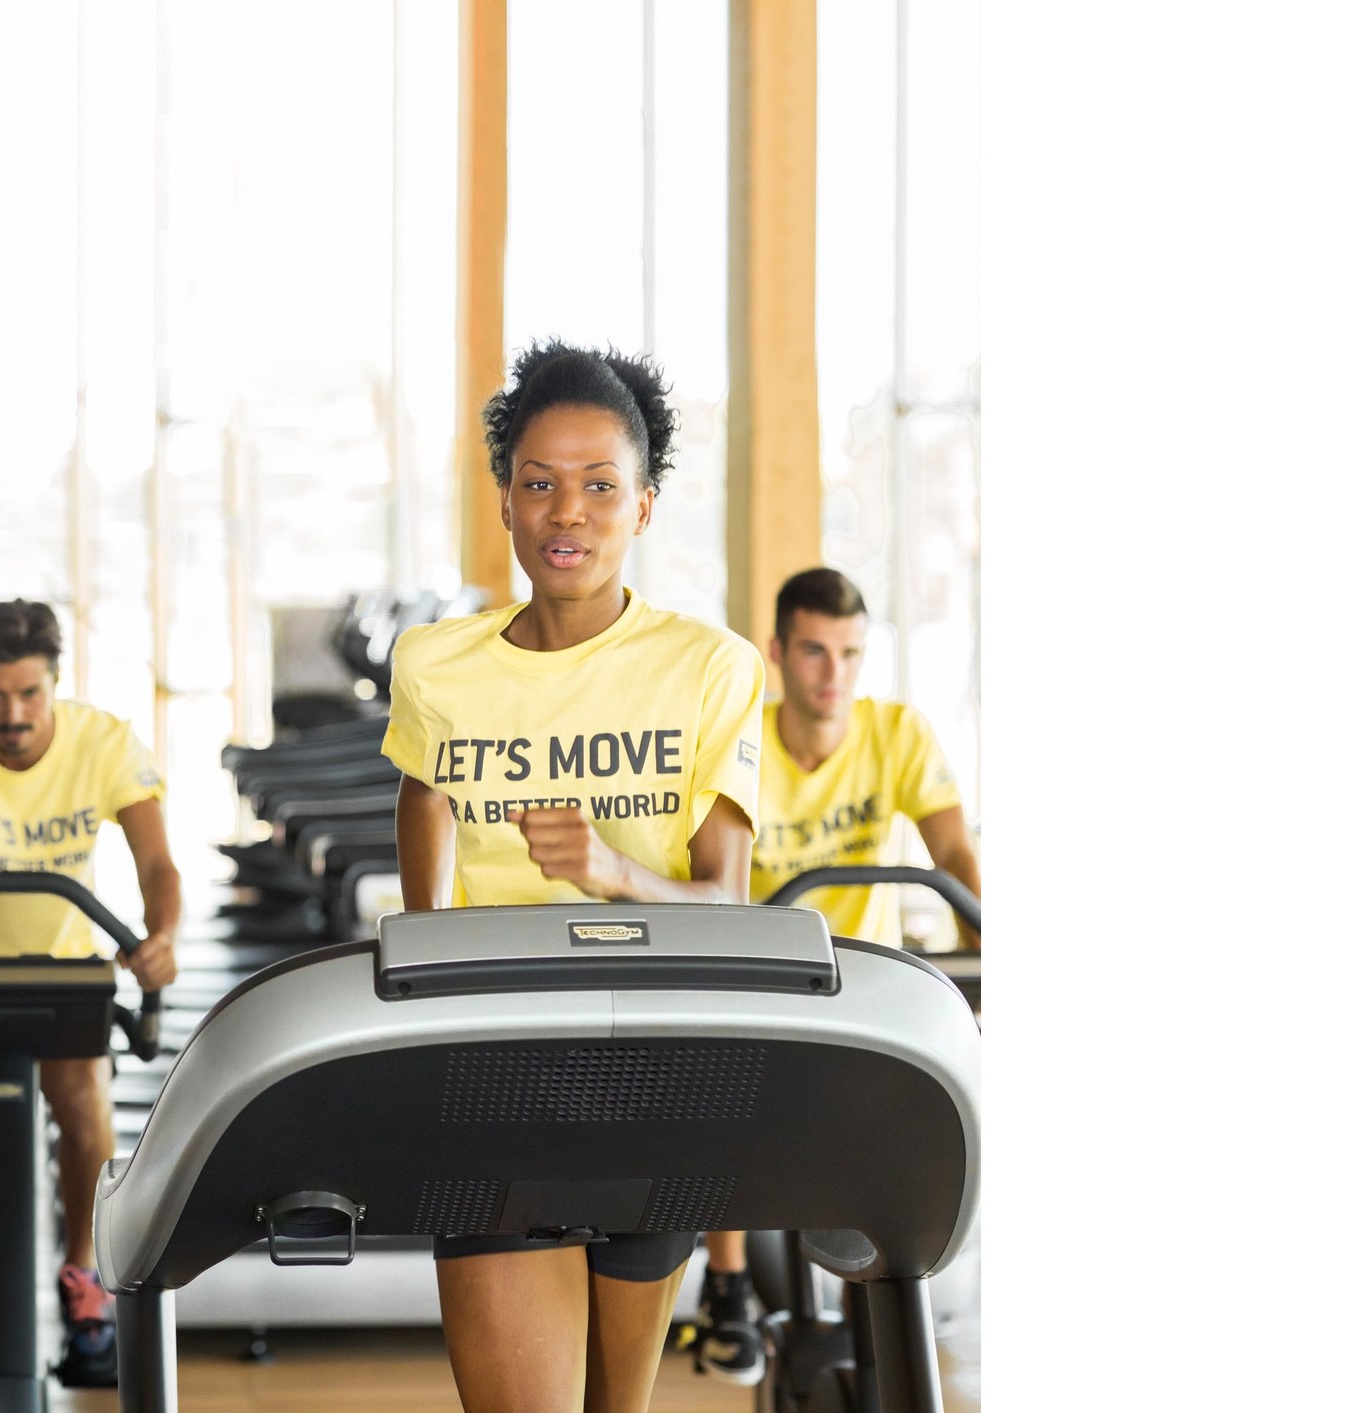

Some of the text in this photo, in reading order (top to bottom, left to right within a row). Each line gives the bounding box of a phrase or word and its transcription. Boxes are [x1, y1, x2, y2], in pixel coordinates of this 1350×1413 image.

[434, 738, 532, 784] LET'S
[550, 730, 682, 780] MOVE
[464, 800, 478, 824] A
[590, 792, 680, 820] WORLD
